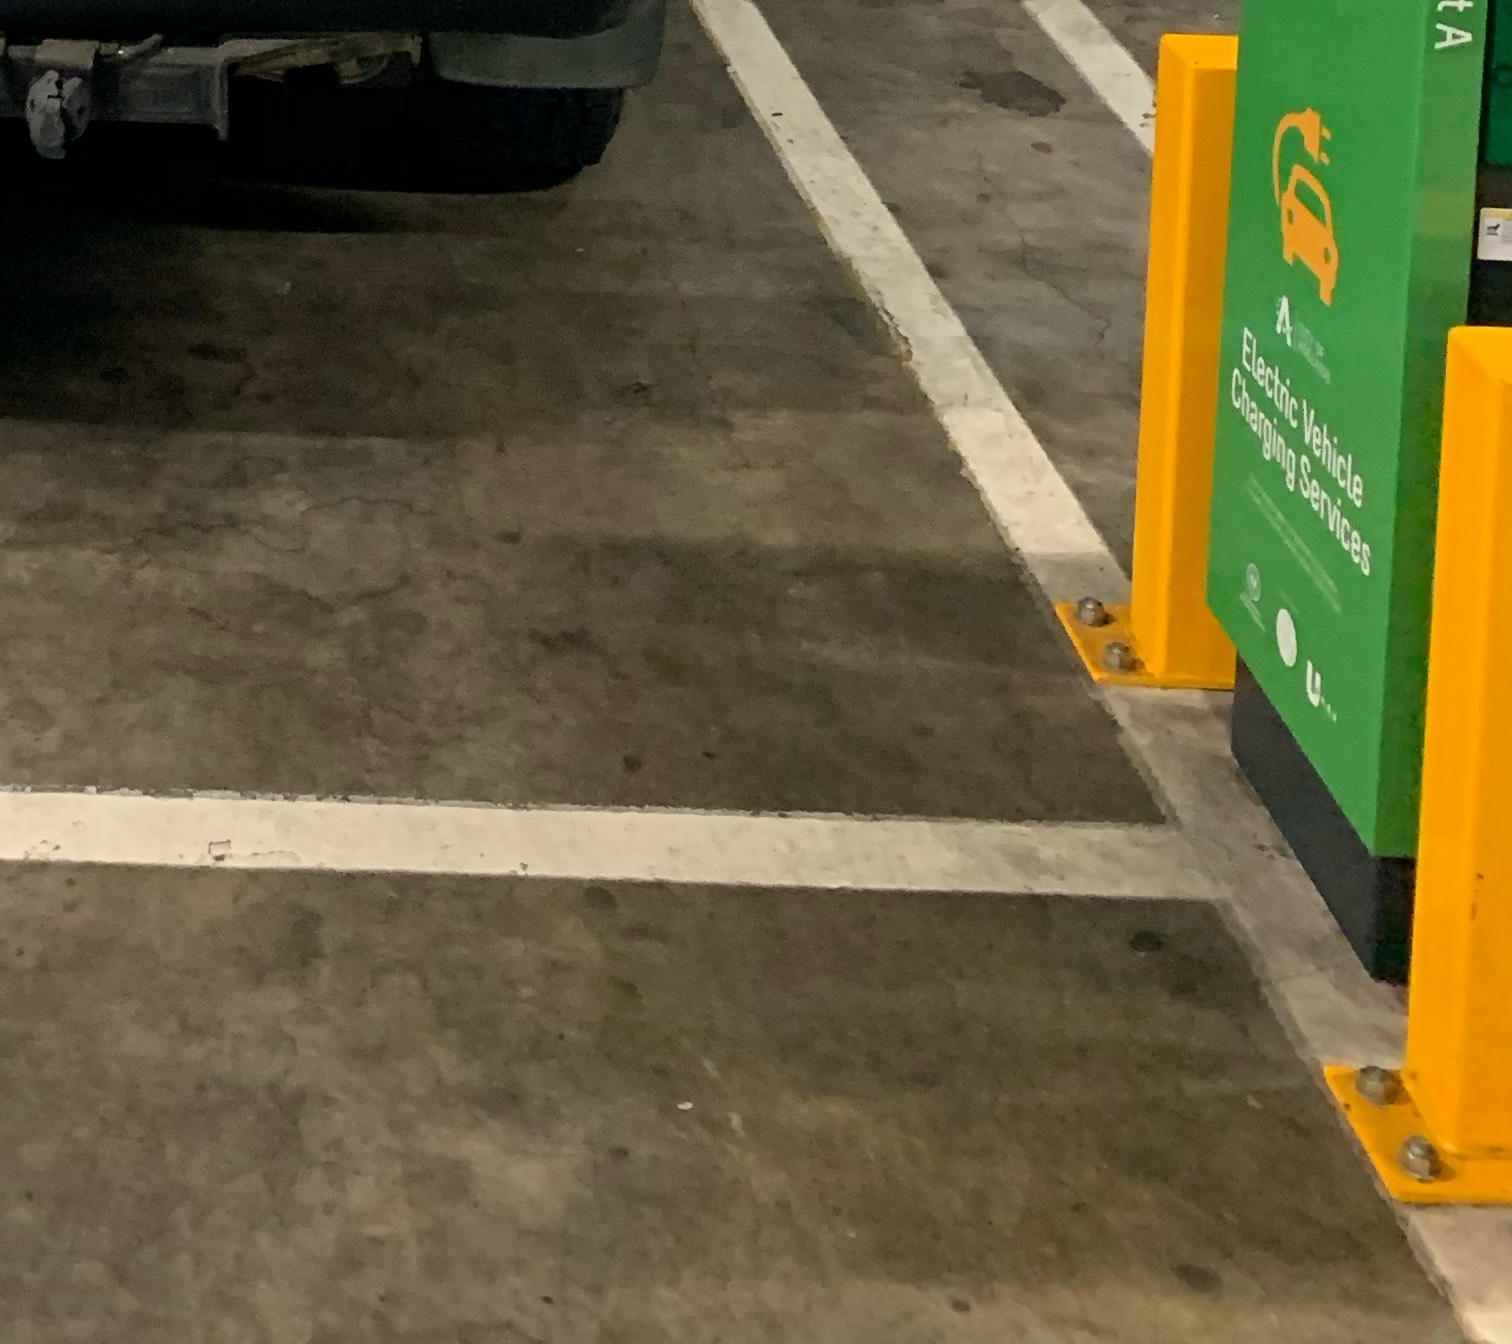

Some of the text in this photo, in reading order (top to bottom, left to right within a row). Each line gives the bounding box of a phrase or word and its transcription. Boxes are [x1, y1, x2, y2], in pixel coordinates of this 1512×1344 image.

[1434, 22, 1473, 50] A
[1230, 367, 1297, 493] Charging
[1299, 454, 1371, 577] Services
[1241, 326, 1298, 429] Electric
[1302, 398, 1364, 508] Vehicle
